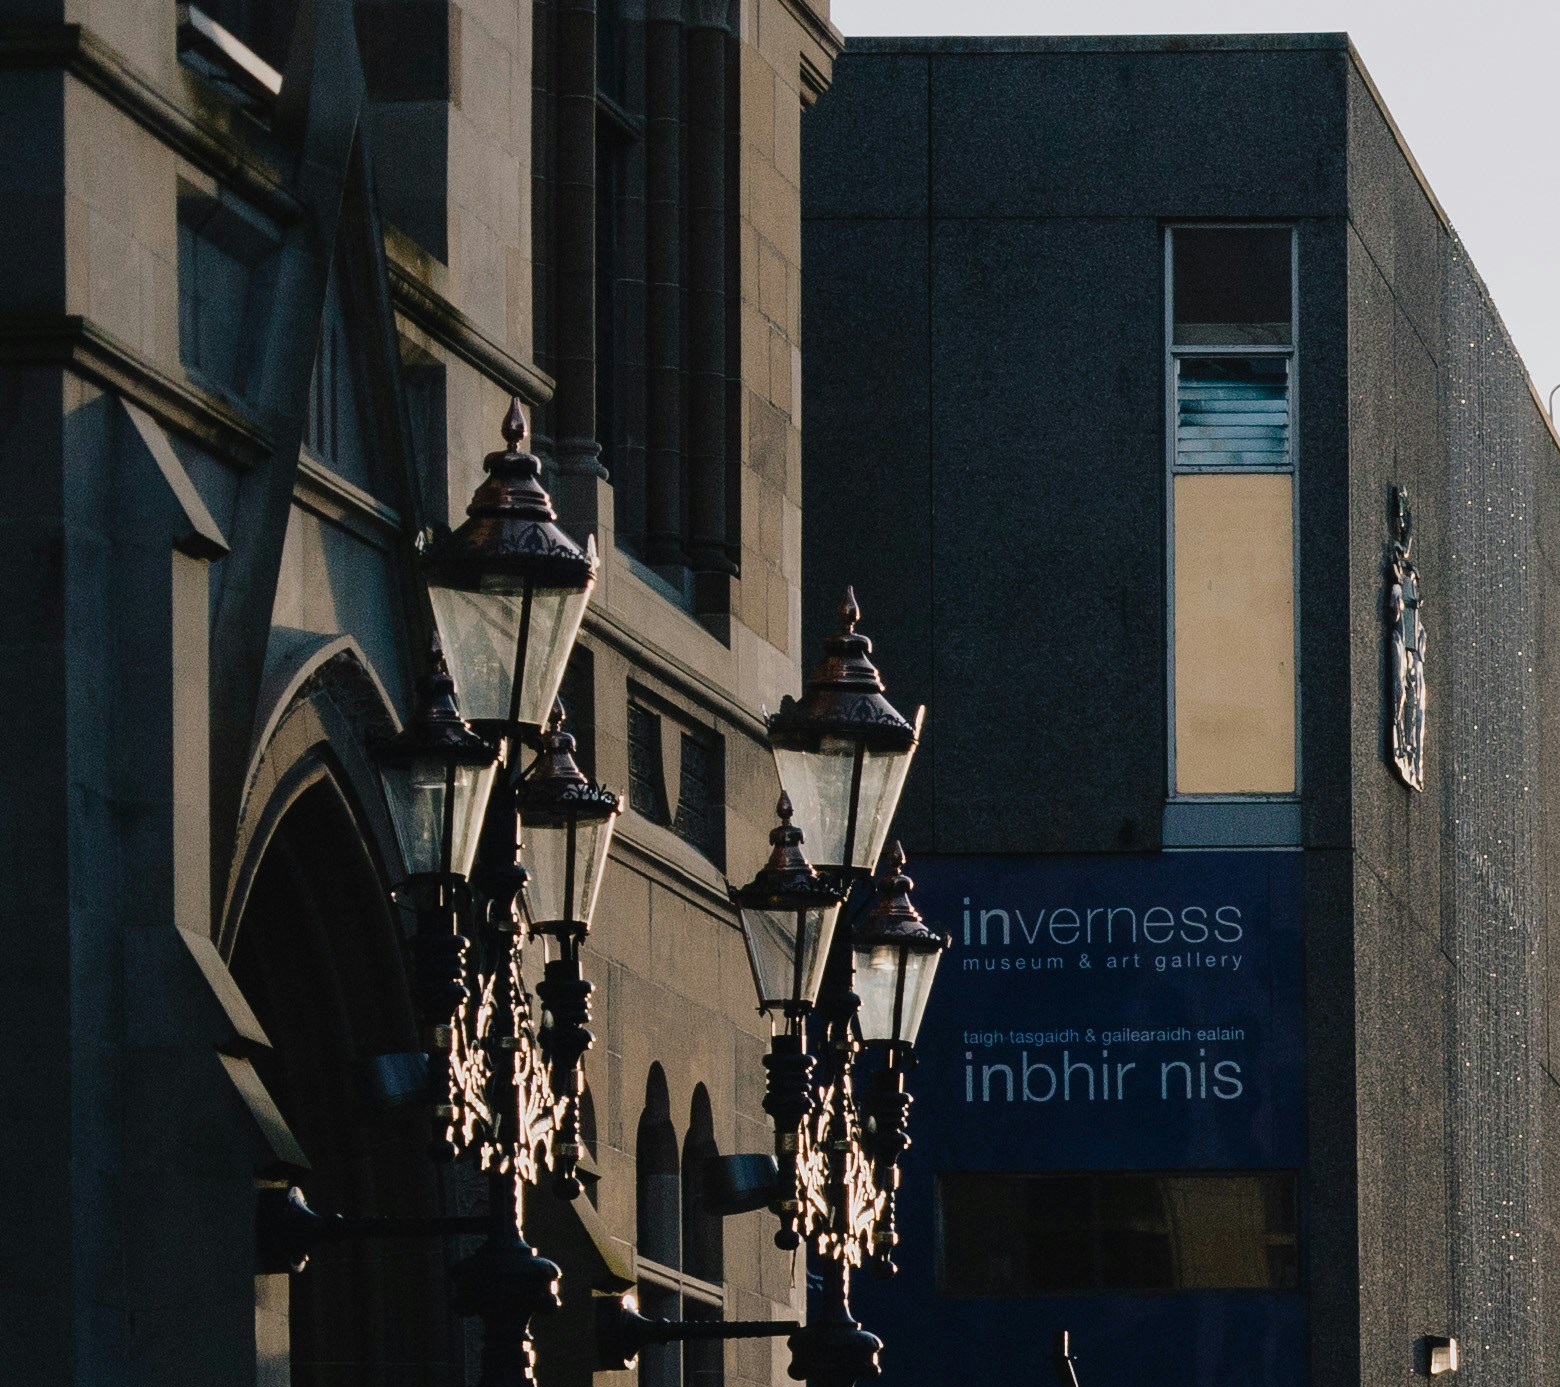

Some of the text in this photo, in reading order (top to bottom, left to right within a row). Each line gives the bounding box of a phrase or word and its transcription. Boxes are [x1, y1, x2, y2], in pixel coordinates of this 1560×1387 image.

[963, 896, 1243, 945] inverness
[963, 951, 1243, 972] museum & art gallery
[963, 1027, 1245, 1047] taigh-tasgaidh & gailearaidh ealain
[964, 1048, 1244, 1103] inbhir nis
